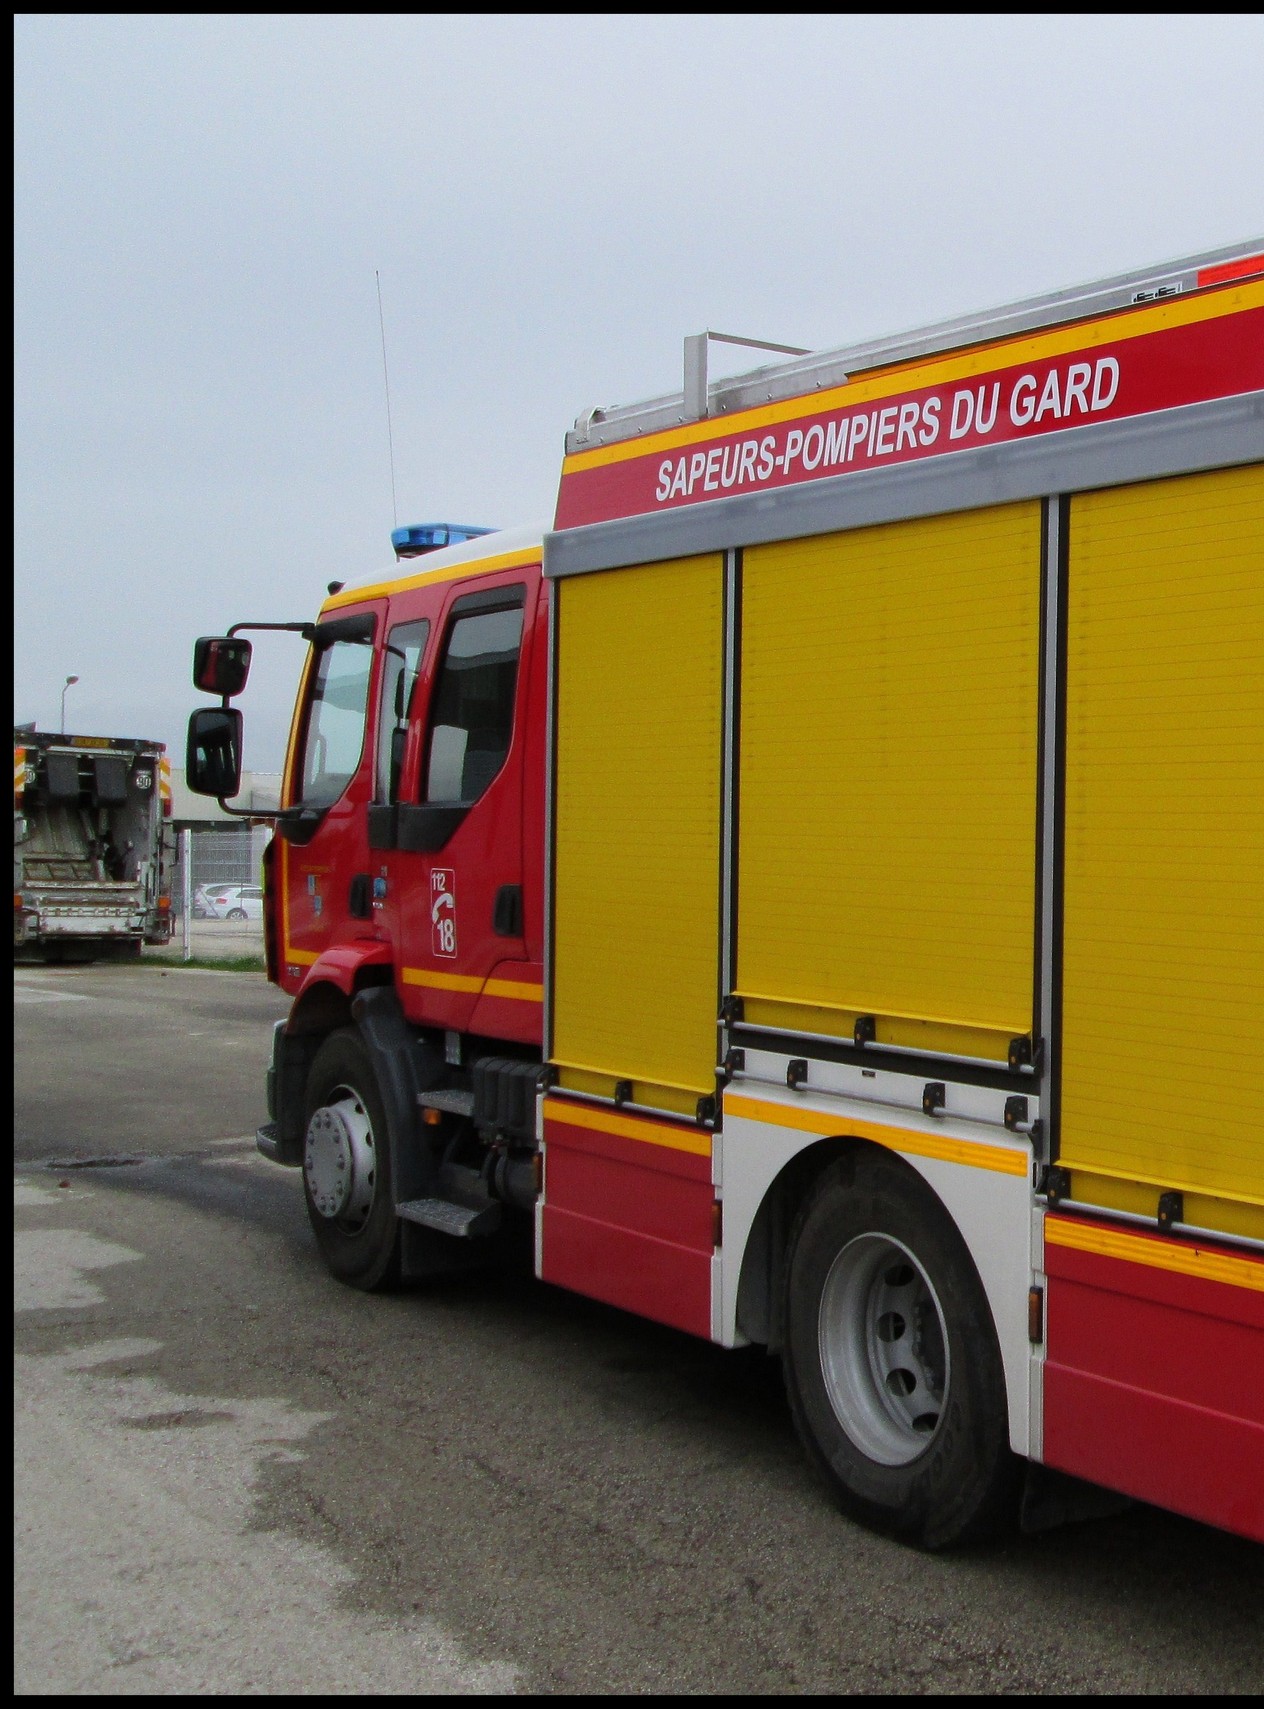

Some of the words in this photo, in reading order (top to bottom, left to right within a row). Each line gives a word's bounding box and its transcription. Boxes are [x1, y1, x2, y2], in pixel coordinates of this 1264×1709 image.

[655, 397, 942, 501] SAPEURS-POMPIERS
[950, 382, 1000, 439] DU
[1010, 357, 1120, 426] GARD
[138, 776, 150, 788] 90
[432, 872, 446, 891] 112
[437, 918, 455, 953] 18
